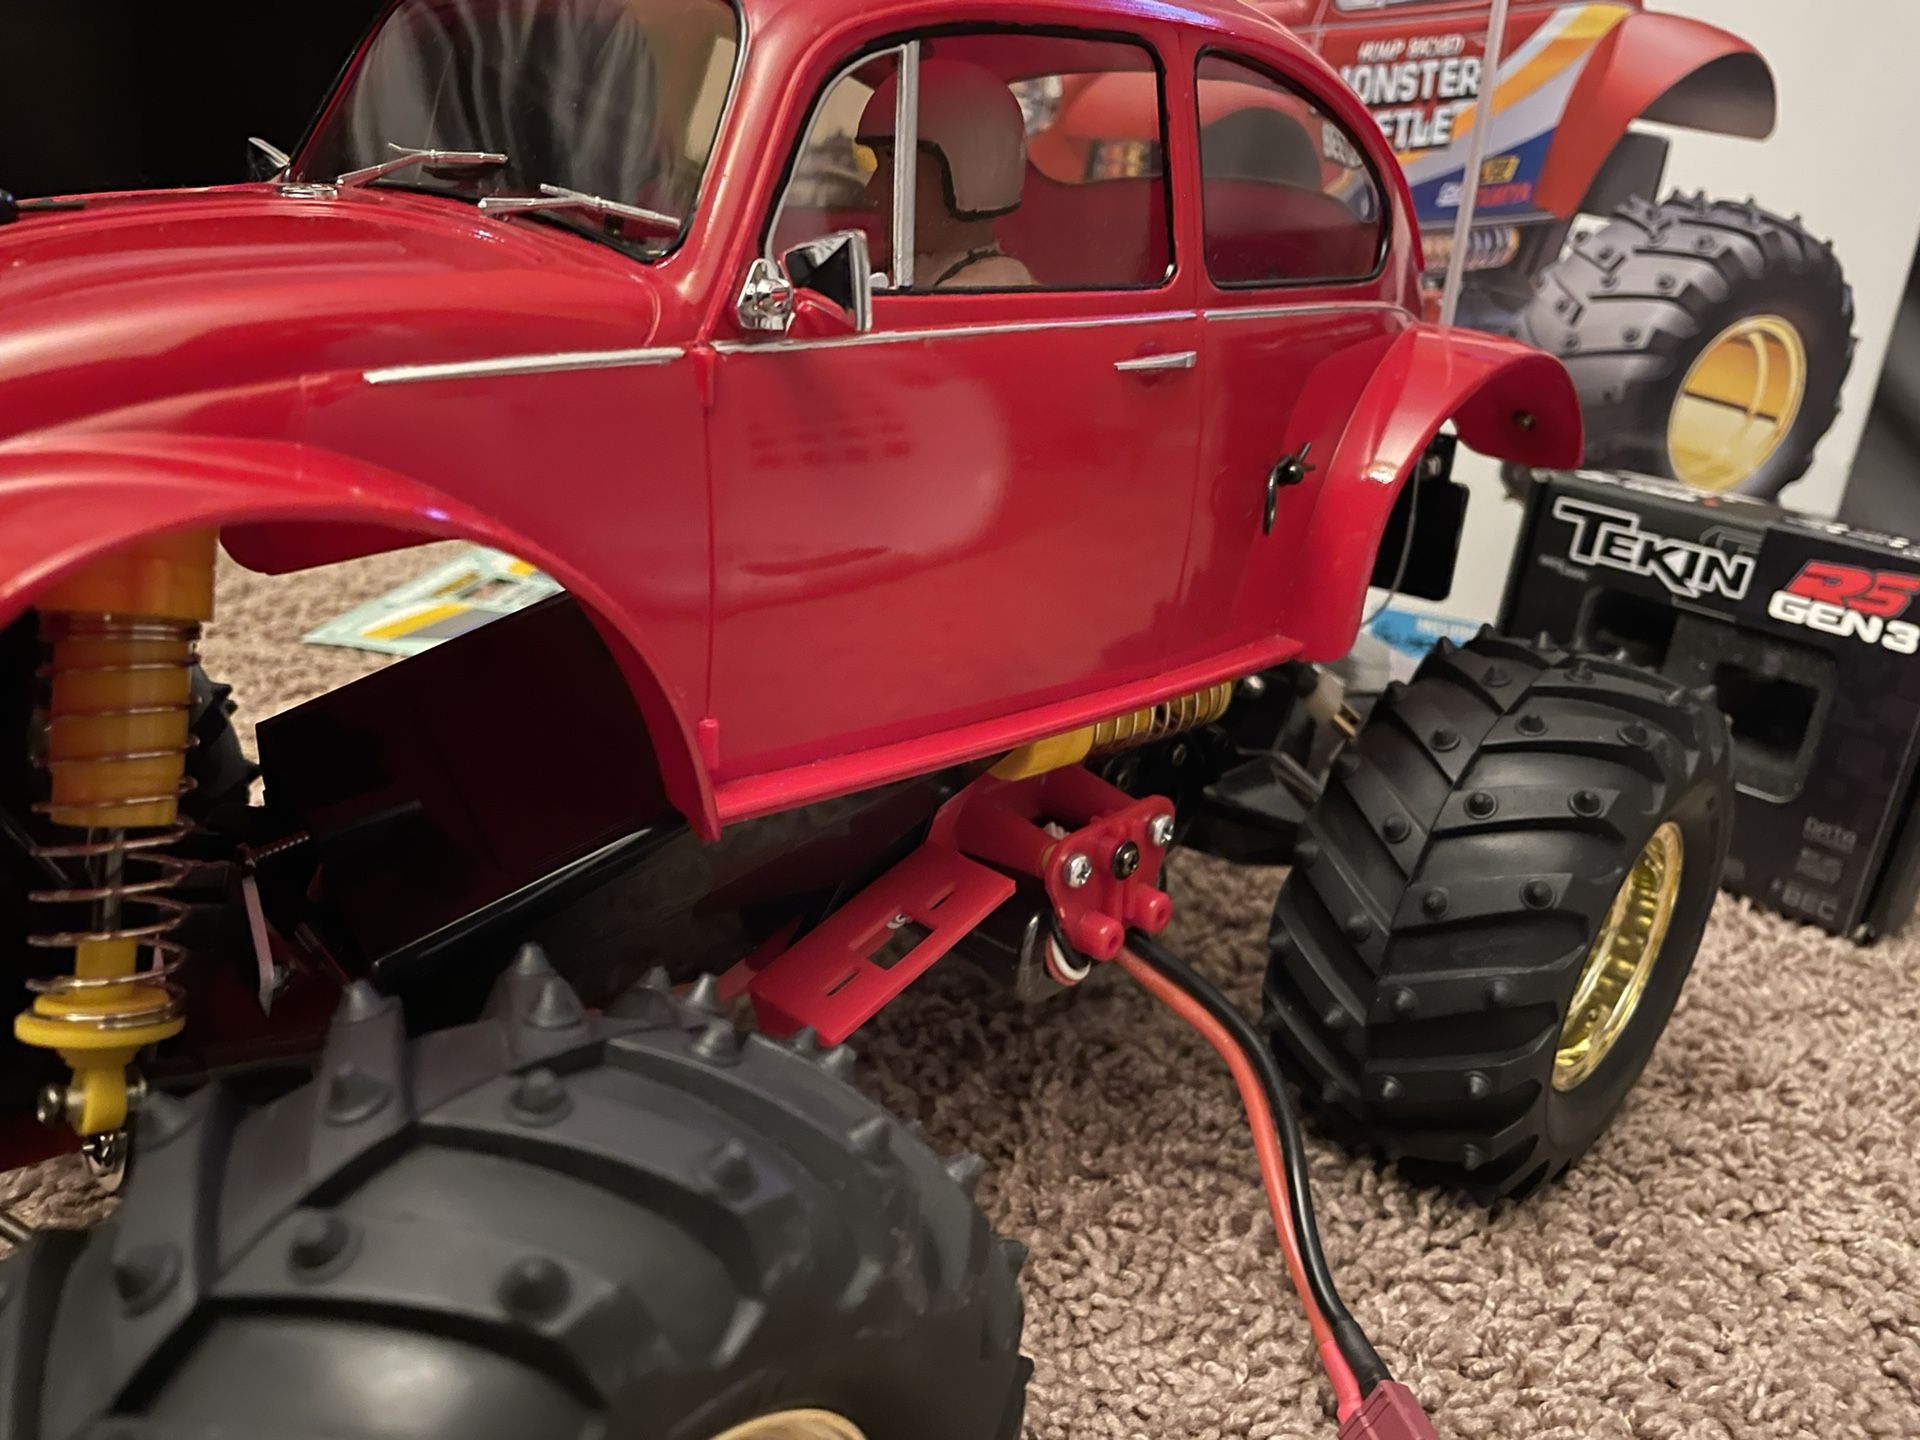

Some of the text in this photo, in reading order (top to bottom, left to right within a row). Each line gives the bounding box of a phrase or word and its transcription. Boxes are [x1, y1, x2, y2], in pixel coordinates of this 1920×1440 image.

[1340, 56, 1482, 105] ONSTER
[1553, 496, 1755, 600] TEKIN
[1783, 559, 1920, 619] RS
